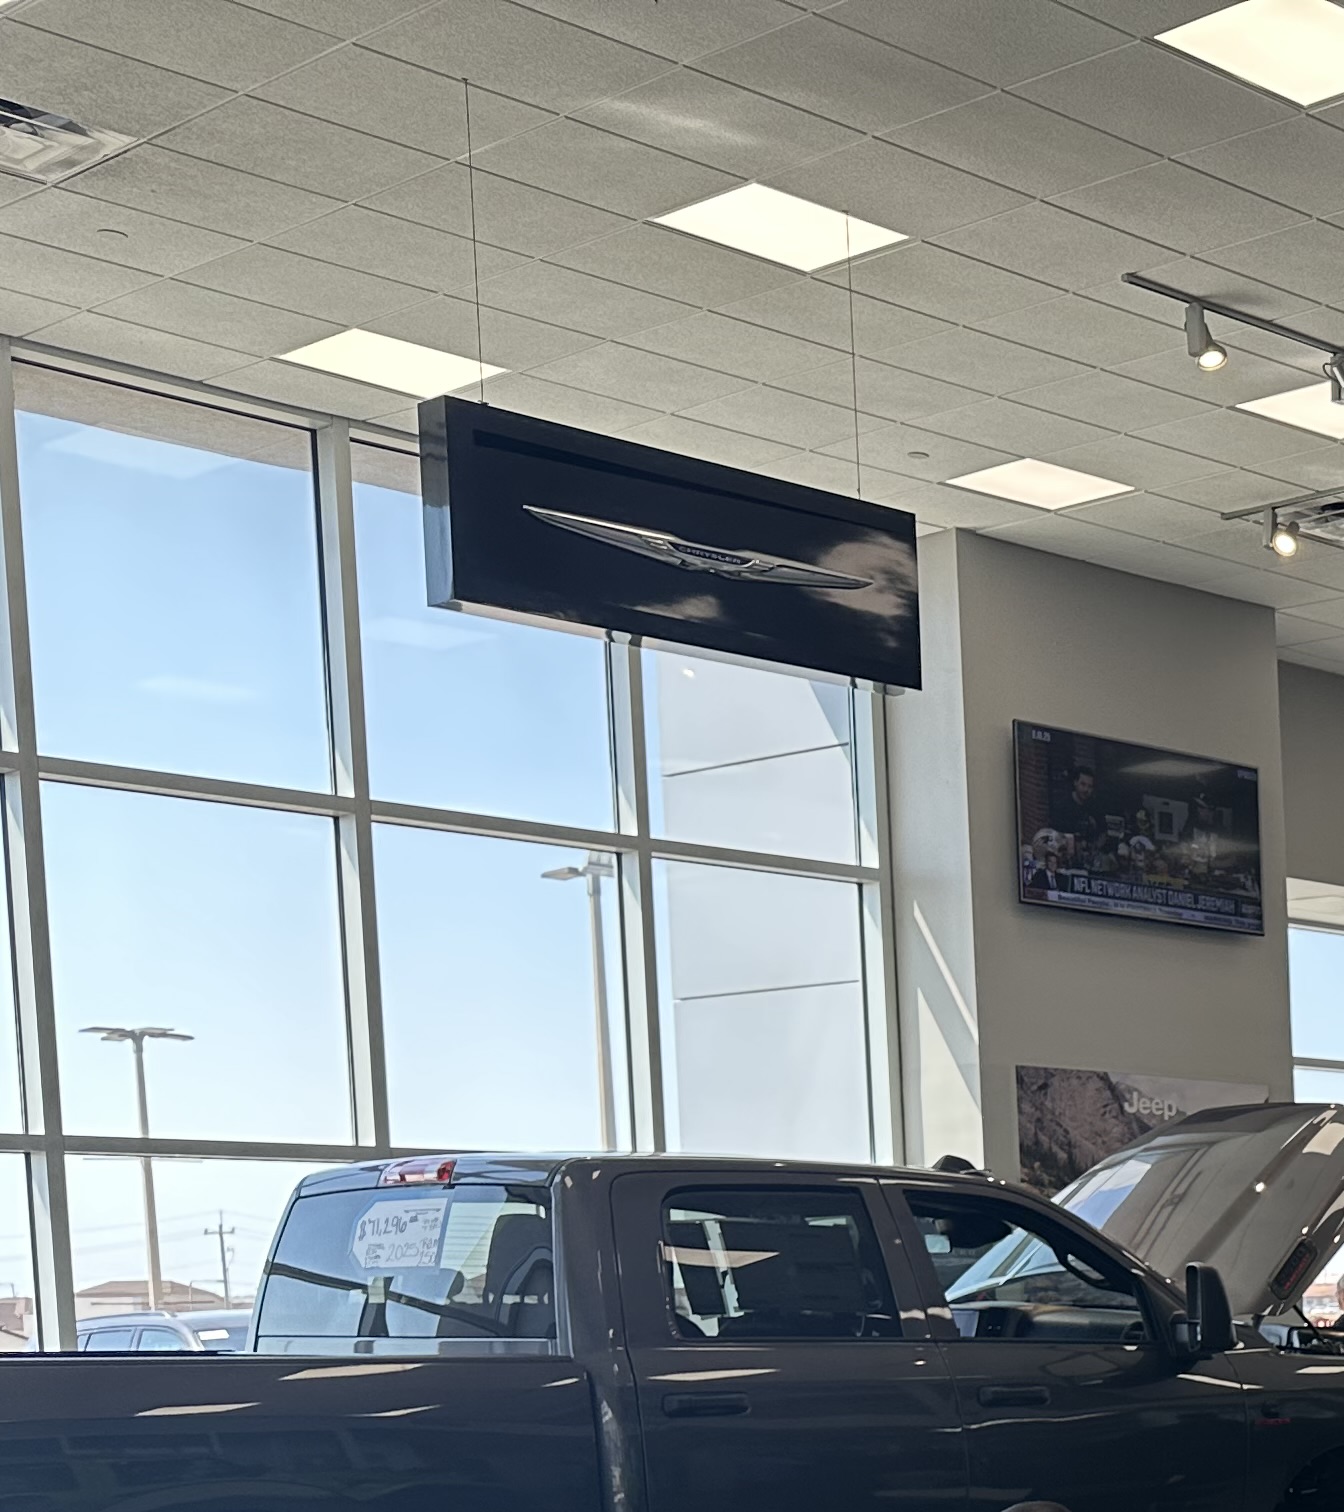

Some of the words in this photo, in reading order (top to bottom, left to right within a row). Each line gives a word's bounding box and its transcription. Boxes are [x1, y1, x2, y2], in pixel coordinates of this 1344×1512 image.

[678, 546, 742, 565] CHRYSLER
[1073, 877, 1091, 893] NFL
[1091, 880, 1132, 899] NETWORK
[1132, 886, 1168, 904] ANALYST
[1168, 890, 1197, 909] DANIEL
[1124, 1091, 1177, 1120] Jeep
[386, 1242, 419, 1262] 2025
